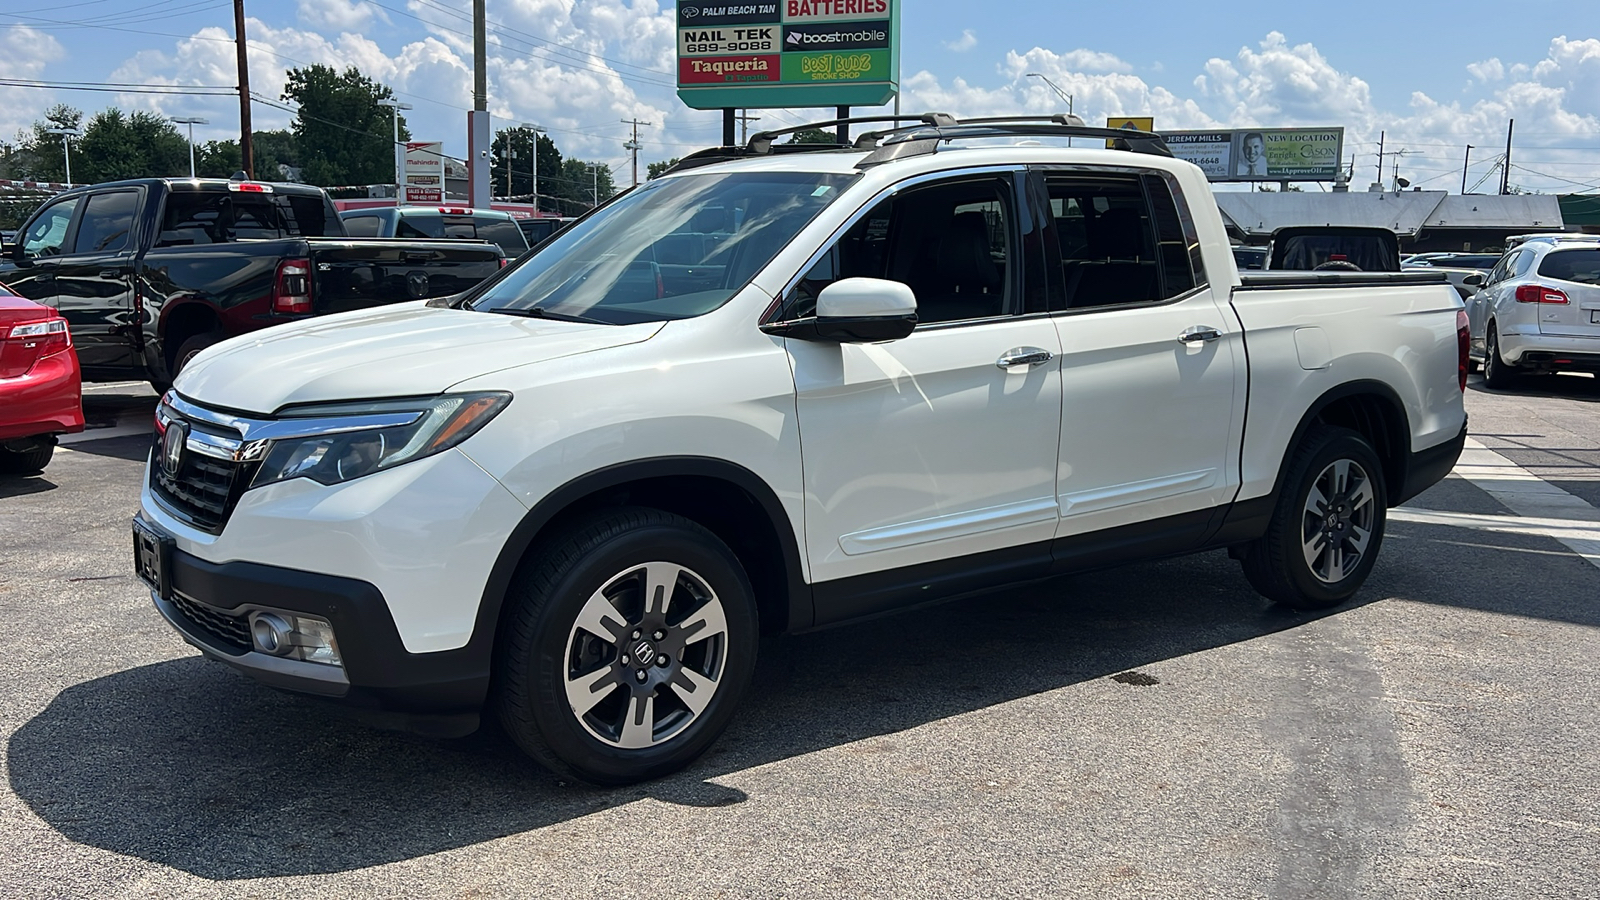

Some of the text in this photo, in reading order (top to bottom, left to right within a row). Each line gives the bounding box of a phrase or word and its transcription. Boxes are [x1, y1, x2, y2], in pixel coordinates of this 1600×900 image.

[702, 4, 776, 17] PALM BEACH TAN
[787, 0, 887, 17] BATTERIES
[684, 28, 773, 42] NAIL TEK
[686, 41, 772, 53] 689-9088
[691, 57, 769, 75] Taquería
[811, 71, 861, 80] SMOKE SHOP
[1166, 134, 1222, 143] JEREMY MILLS
[1289, 134, 1337, 142] LOCATION
[1268, 151, 1297, 160] Enright
